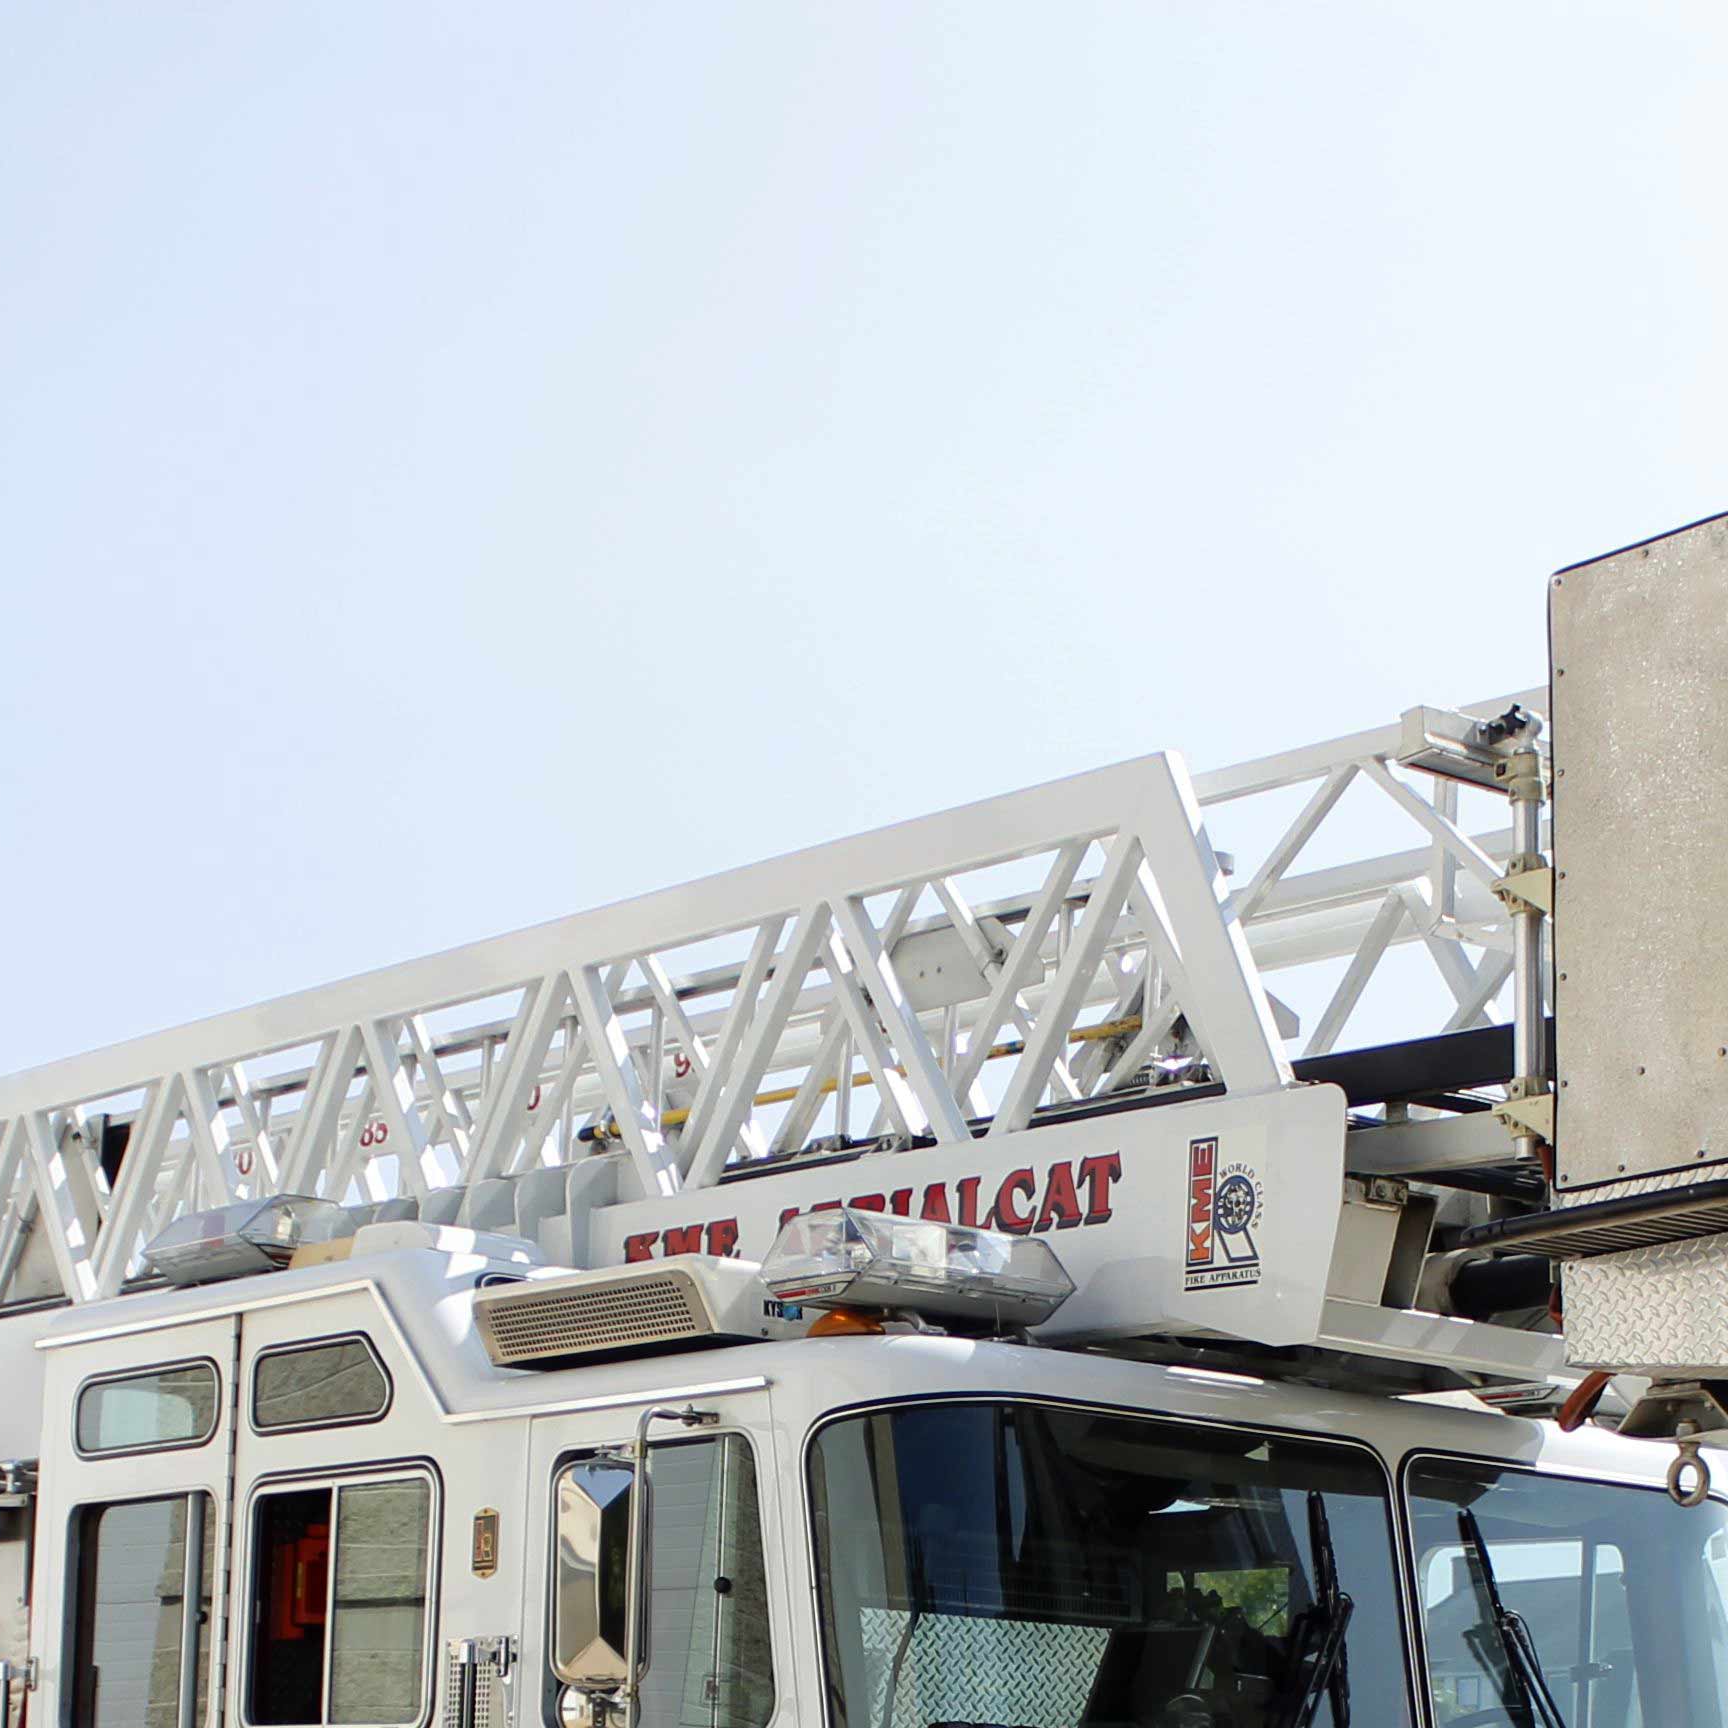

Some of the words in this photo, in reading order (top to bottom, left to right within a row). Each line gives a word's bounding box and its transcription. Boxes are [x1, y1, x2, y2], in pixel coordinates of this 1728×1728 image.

[624, 1217, 741, 1264] KME
[777, 1151, 1122, 1236] IALCAT
[1189, 1143, 1214, 1261] KME
[1219, 1162, 1255, 1180] WORLD
[1251, 1181, 1265, 1230] CLASS
[1185, 1273, 1206, 1286] FIRE
[1209, 1267, 1262, 1283] APPARATUS
